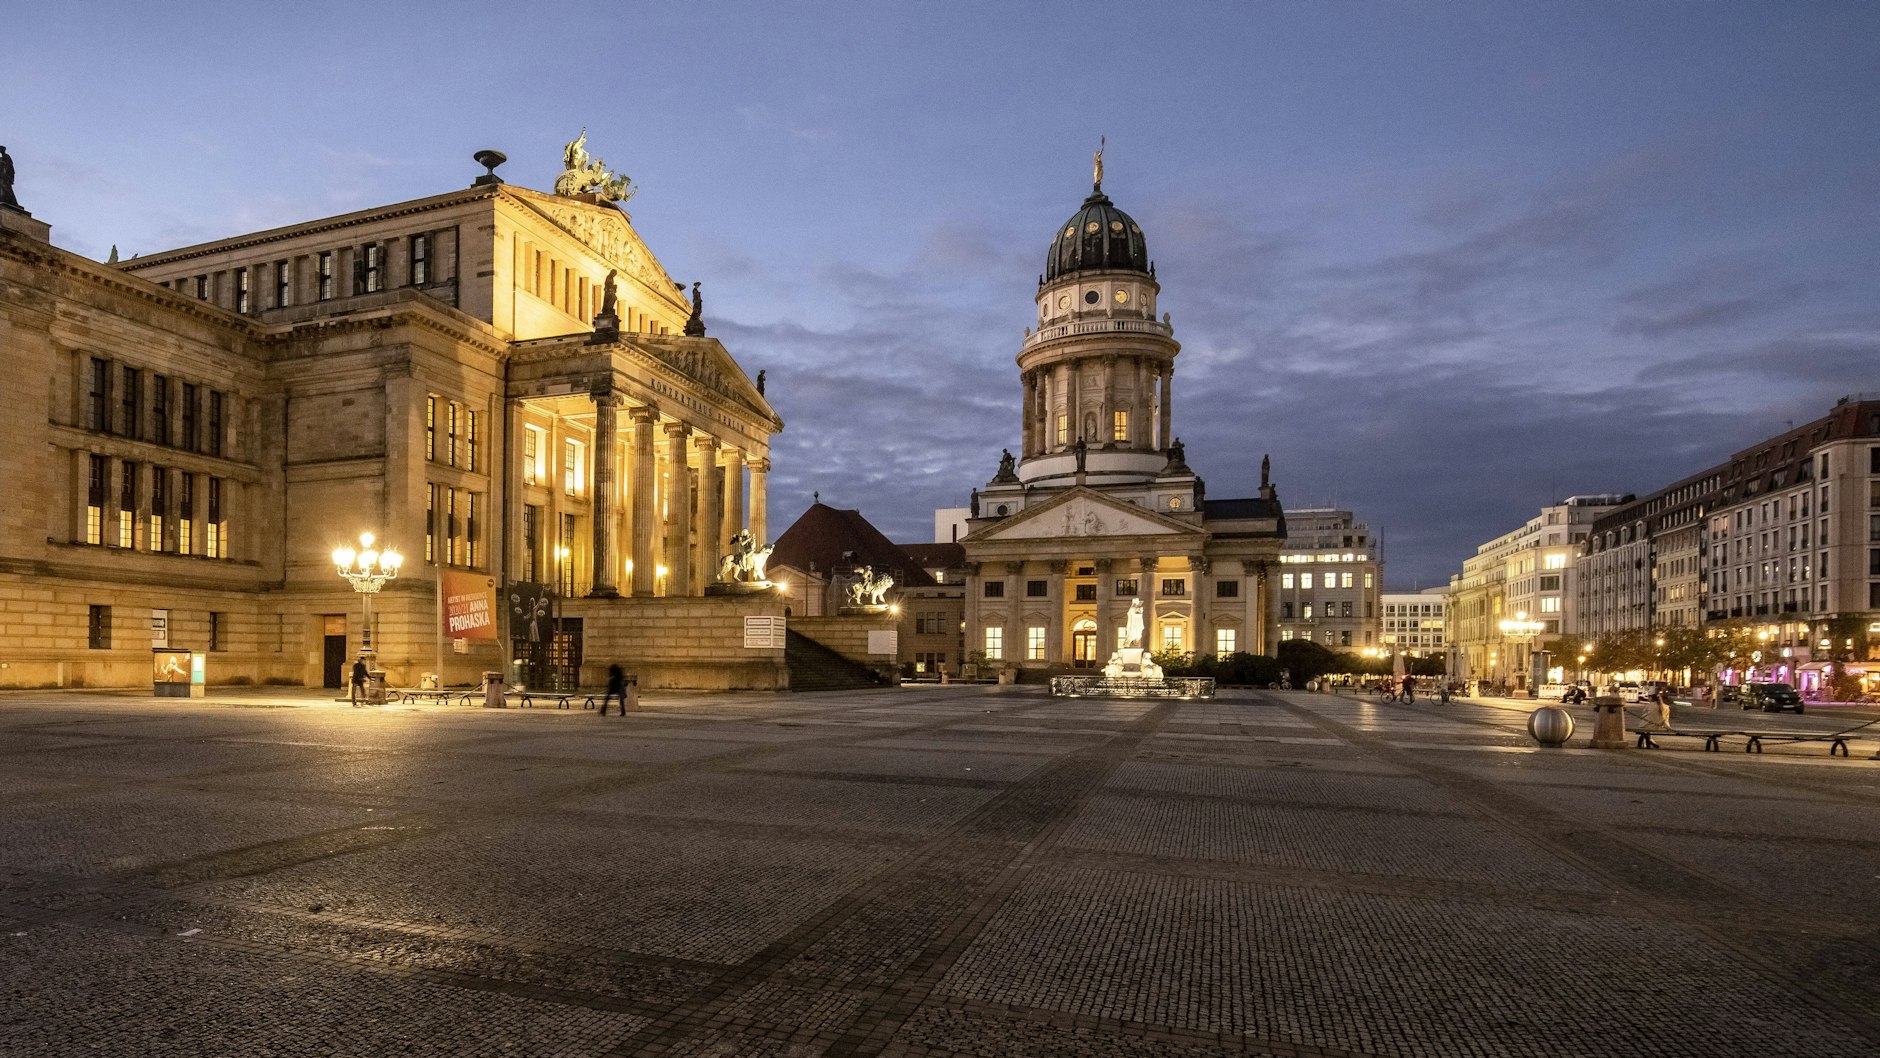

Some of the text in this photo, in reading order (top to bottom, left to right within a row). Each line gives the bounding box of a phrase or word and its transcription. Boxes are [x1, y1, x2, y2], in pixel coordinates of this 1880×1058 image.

[651, 378, 744, 433] KONZERTHAUS BERLIN
[470, 599, 488, 612] ANNA
[449, 611, 490, 632] PROHASKA
